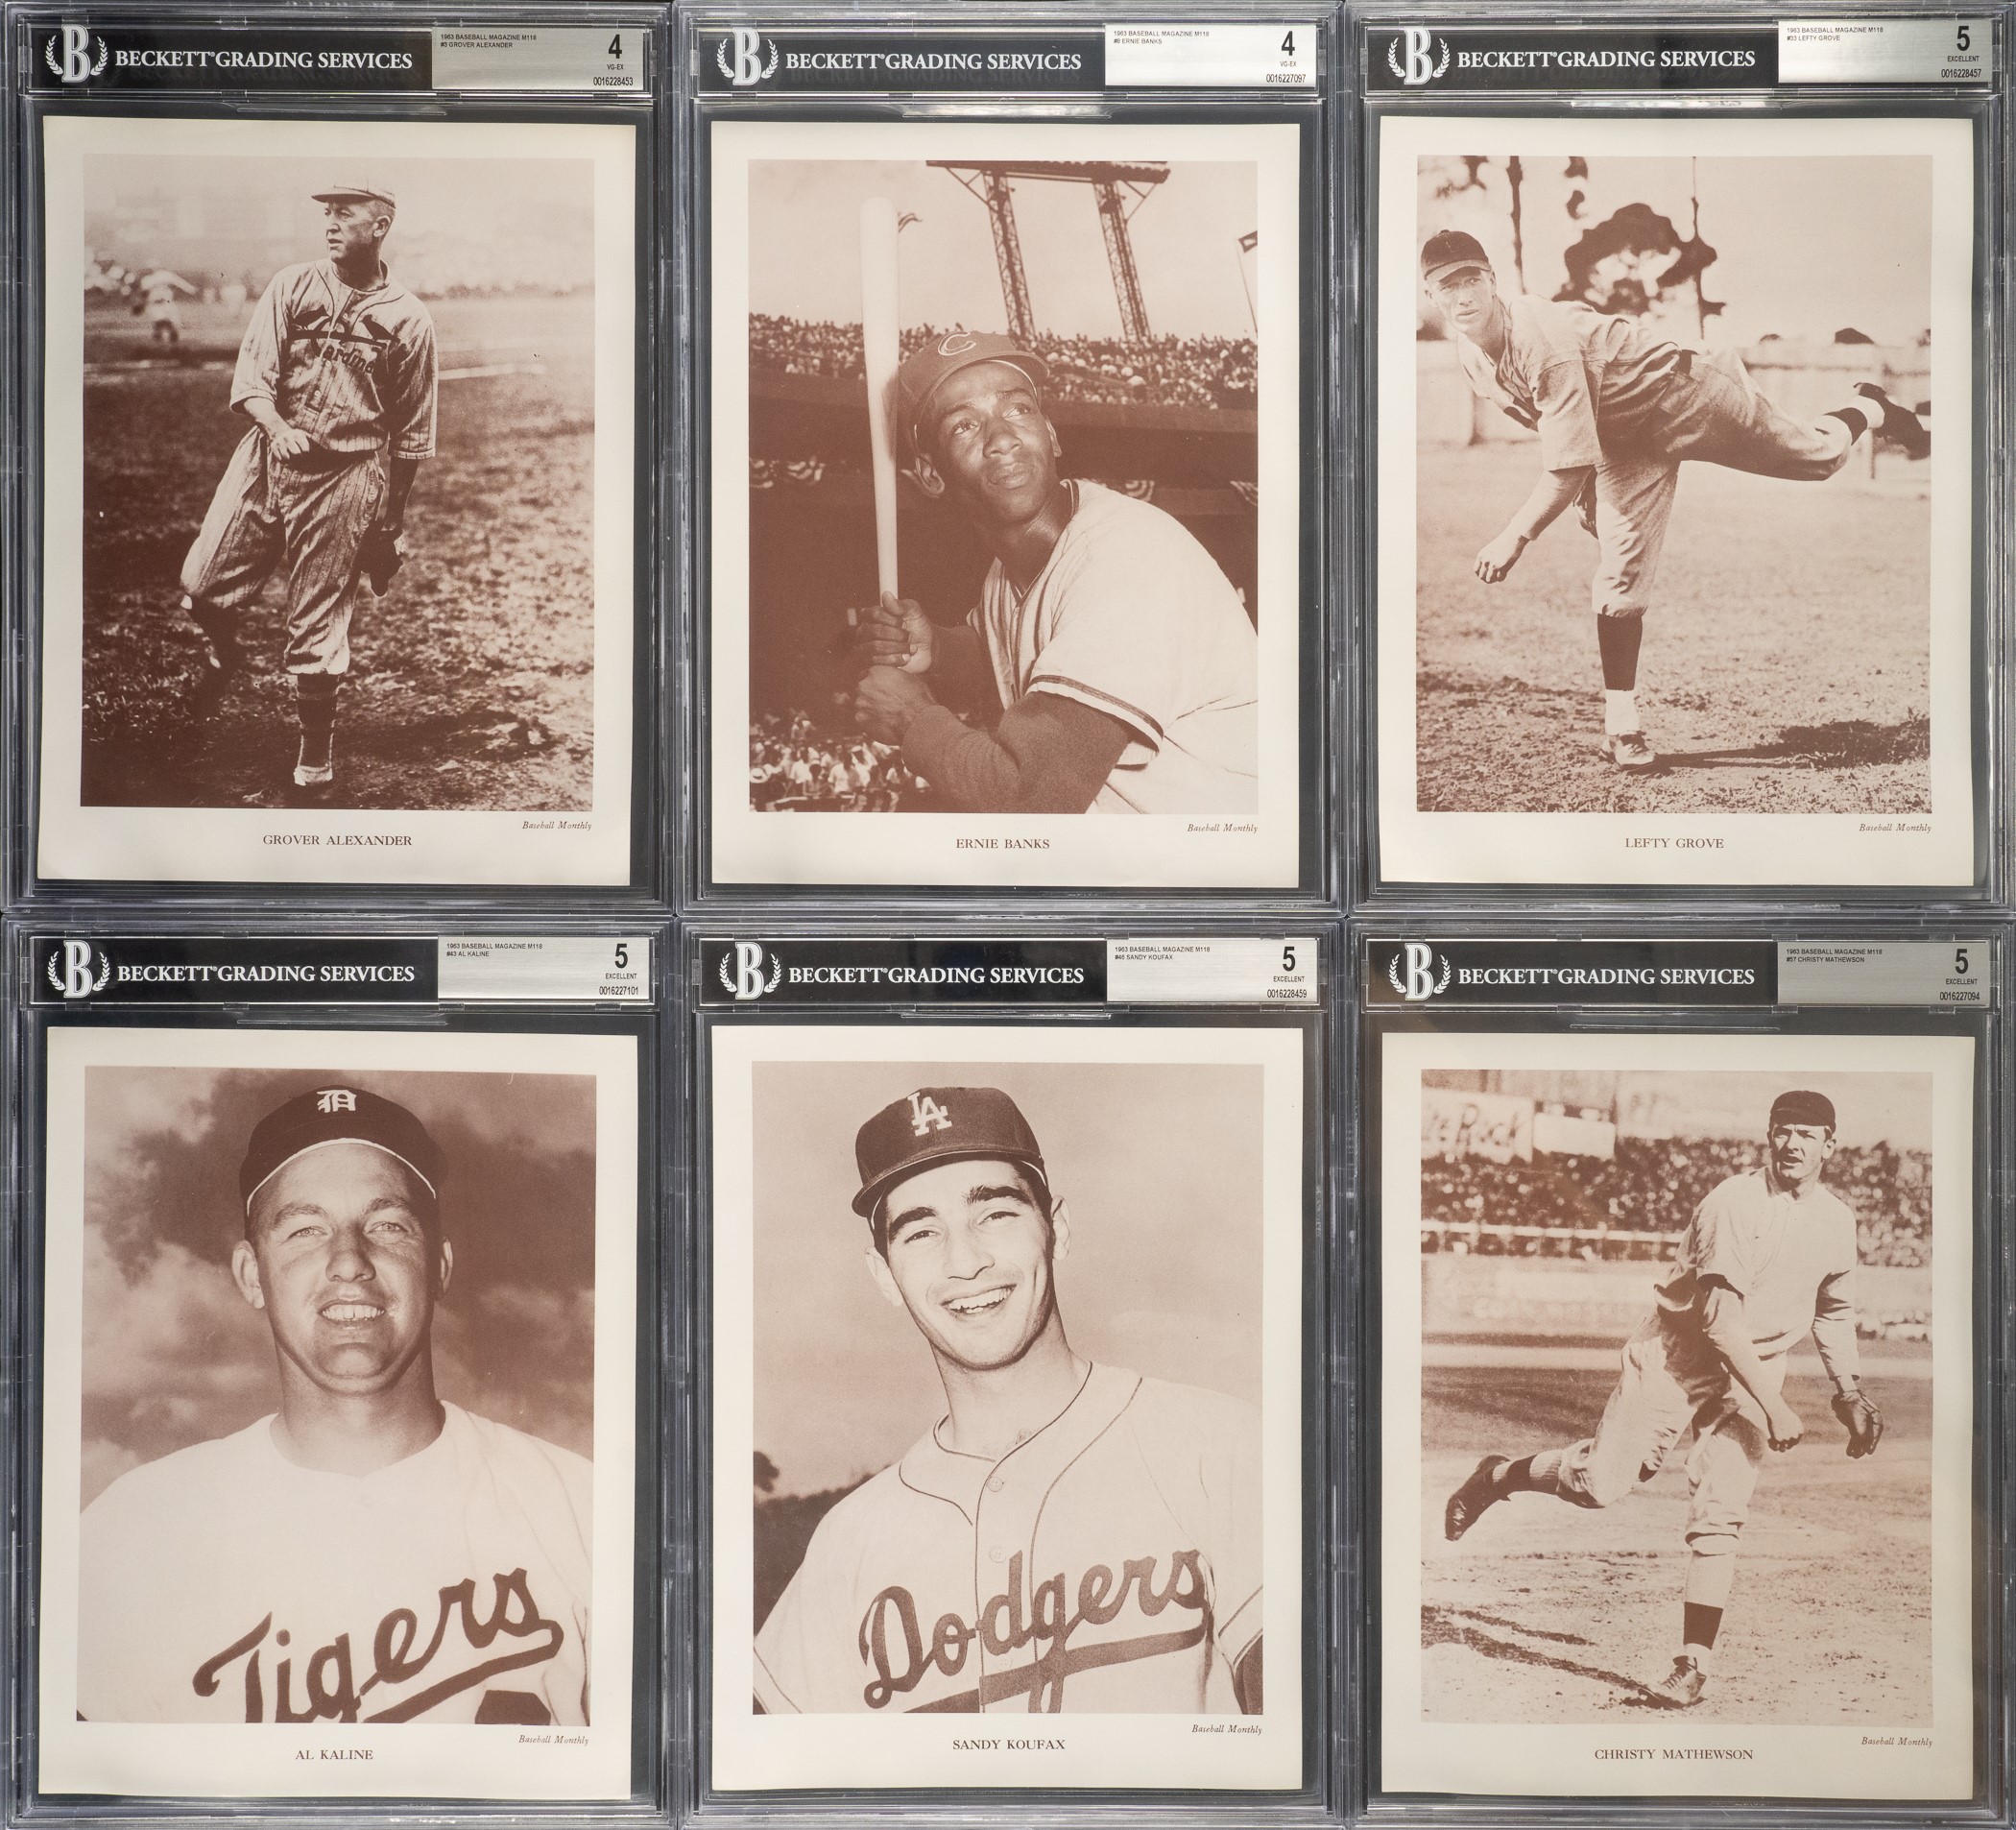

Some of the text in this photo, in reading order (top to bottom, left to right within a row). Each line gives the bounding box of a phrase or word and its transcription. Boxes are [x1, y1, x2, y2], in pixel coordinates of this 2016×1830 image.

[608, 34, 623, 60] 4
[1281, 30, 1296, 57] 4
[1956, 25, 1971, 52] 5
[61, 24, 90, 84] B
[215, 50, 314, 69] GRADING
[317, 51, 413, 69] SERVICES
[732, 27, 761, 85] B
[885, 53, 984, 71] GRADING
[987, 54, 1083, 71] SERVICES
[1404, 26, 1431, 84] B
[1557, 50, 1656, 68] GRADING
[1659, 51, 1755, 68] SERVICES
[593, 77, 634, 86] 0016228453
[1266, 73, 1307, 83] 0016227097
[1941, 69, 1982, 79] 0016228457
[938, 331, 976, 356] C
[521, 820, 591, 831] Baseball Monthly
[1187, 823, 1258, 834] Baseball Monthly
[1859, 823, 1932, 834] Baseball Monthly
[262, 834, 413, 846] GROVER ALEXANDER
[956, 838, 1050, 849] ERNIE BANKS
[1625, 837, 1724, 849] LEFTY GROVE
[614, 943, 629, 969] 5
[1282, 946, 1296, 973] 5
[1955, 948, 1969, 975] 5
[64, 940, 92, 999] B
[217, 965, 316, 983] GRADING
[319, 966, 415, 983] SERVICES
[735, 942, 763, 1000] B
[888, 967, 987, 985] GRADING
[990, 968, 1086, 985] SERVICES
[1404, 943, 1433, 1001] B
[1557, 968, 1656, 986] GRADING
[1659, 969, 1755, 986] SERVICES
[599, 986, 638, 996] 0016227101
[1267, 989, 1308, 999] 0016228459
[1939, 992, 1980, 1001] 0016227094
[317, 1089, 357, 1113] D
[907, 1092, 952, 1136] LA
[859, 1549, 1208, 1714] Dodgers
[193, 1568, 564, 1724] Tigers
[1191, 1723, 1262, 1736] Baseball Monthly
[518, 1734, 589, 1747] Baseball Monthly
[952, 1739, 1066, 1750] SANDY KOUFAX
[1860, 1736, 1932, 1748] Baseball Monthly
[295, 1749, 373, 1760] AL KALINE
[1595, 1748, 1754, 1760] CHRISTY MATHEWSON
